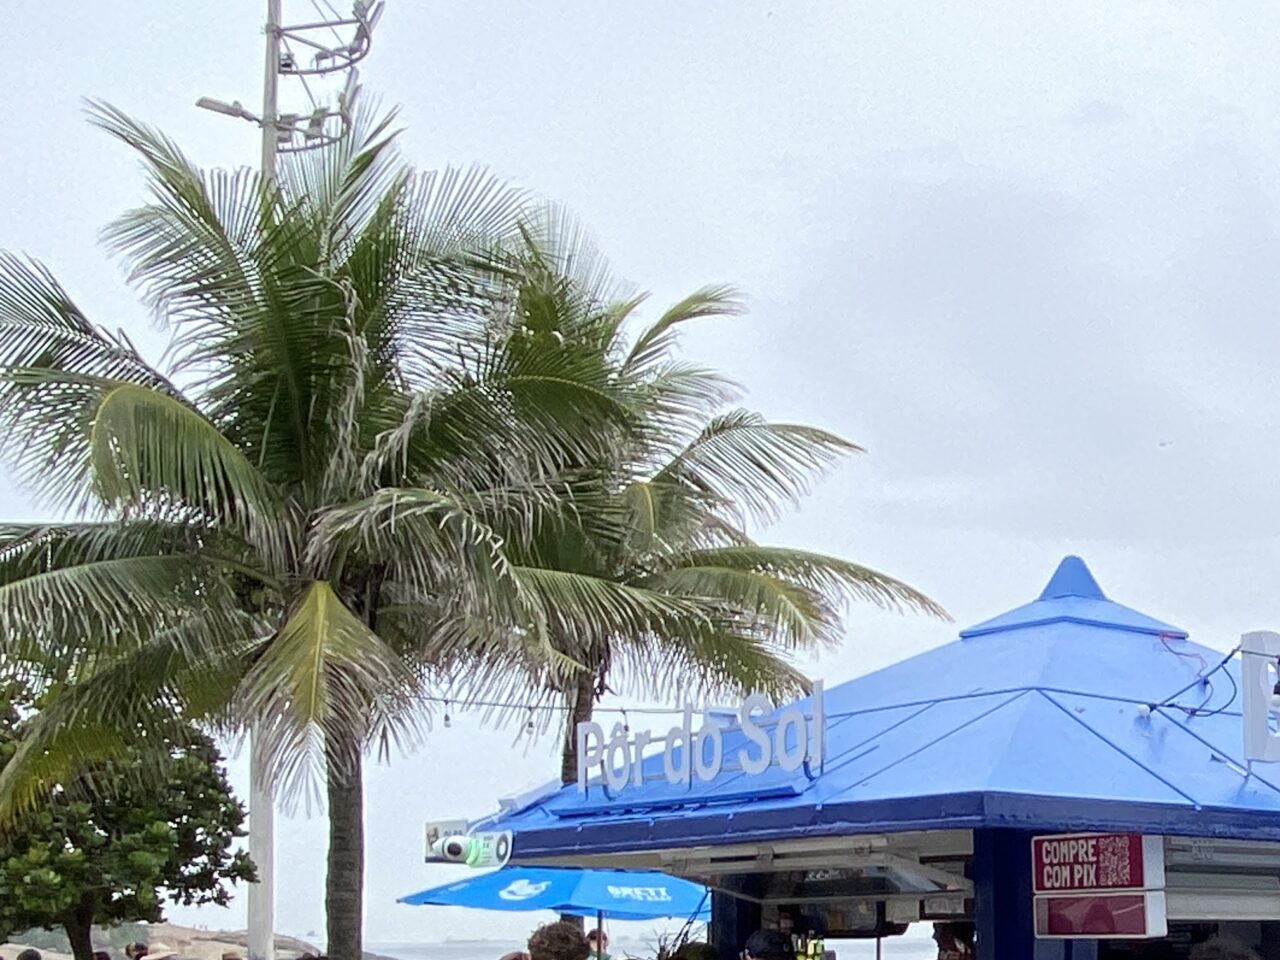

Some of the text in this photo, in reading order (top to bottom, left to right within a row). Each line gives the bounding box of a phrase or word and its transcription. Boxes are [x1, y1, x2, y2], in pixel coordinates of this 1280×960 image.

[577, 679, 825, 794] Pôr do Sol
[1042, 839, 1098, 864] COMPRE
[1043, 864, 1097, 888] COM PIX
